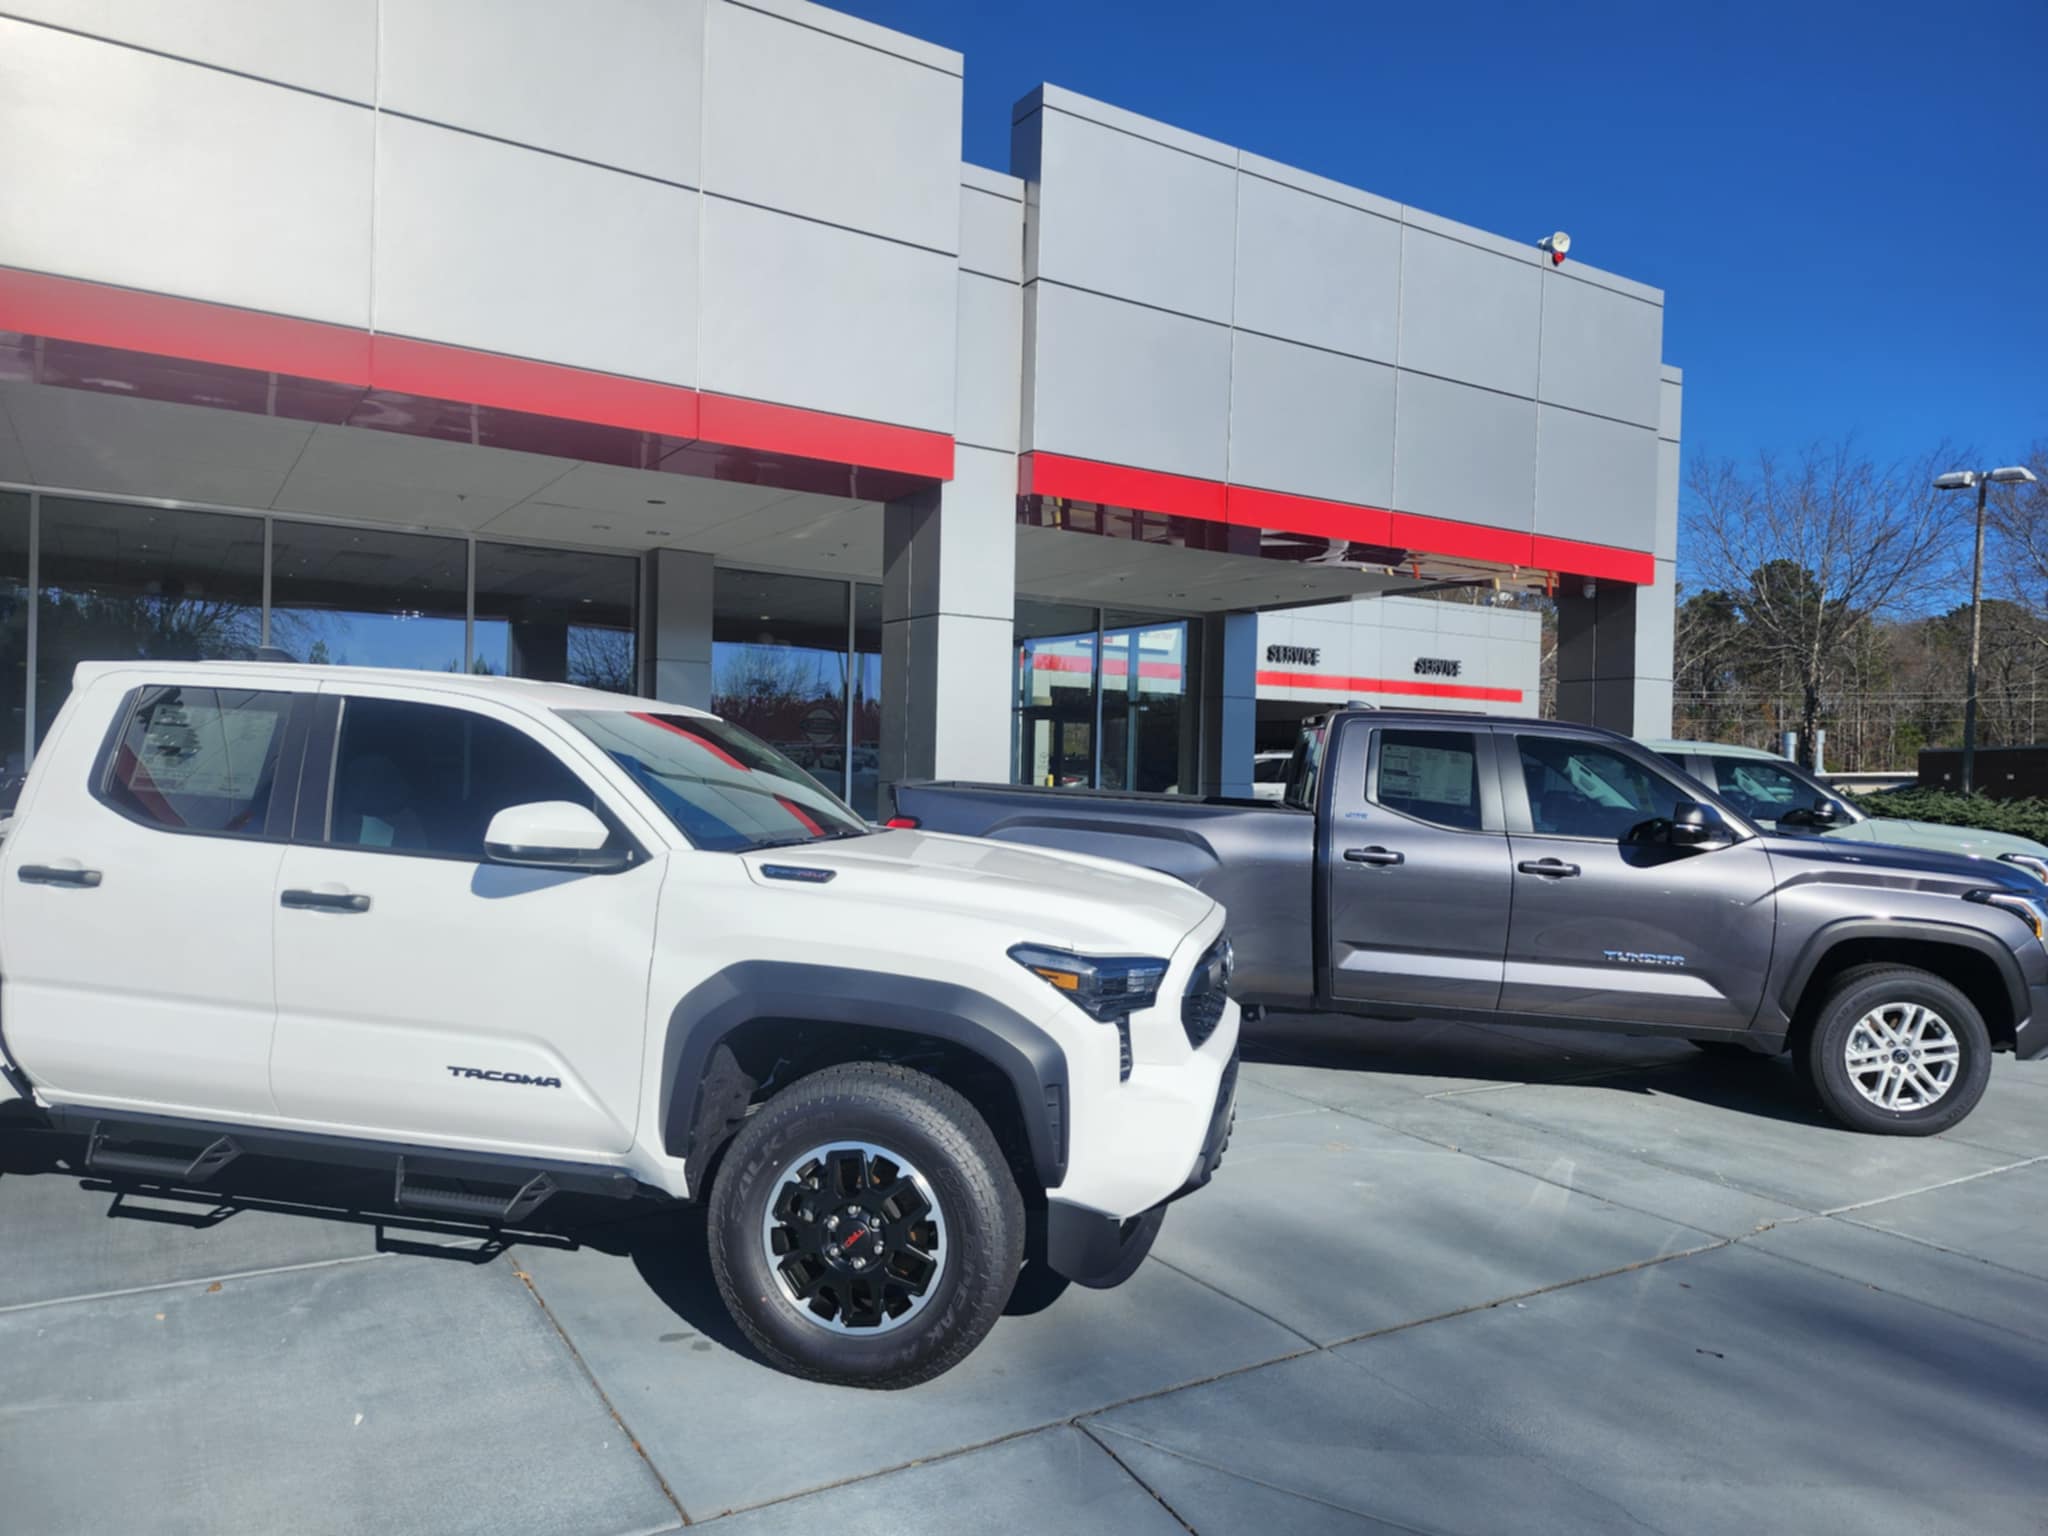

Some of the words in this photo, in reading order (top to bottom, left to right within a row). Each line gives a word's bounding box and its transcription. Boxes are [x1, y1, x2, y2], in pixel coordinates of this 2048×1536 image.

[1267, 645, 1320, 666] SERVICE
[1414, 657, 1461, 677] SERVICE
[1603, 949, 1685, 967] TUNDRA
[447, 1065, 561, 1088] TACOMA
